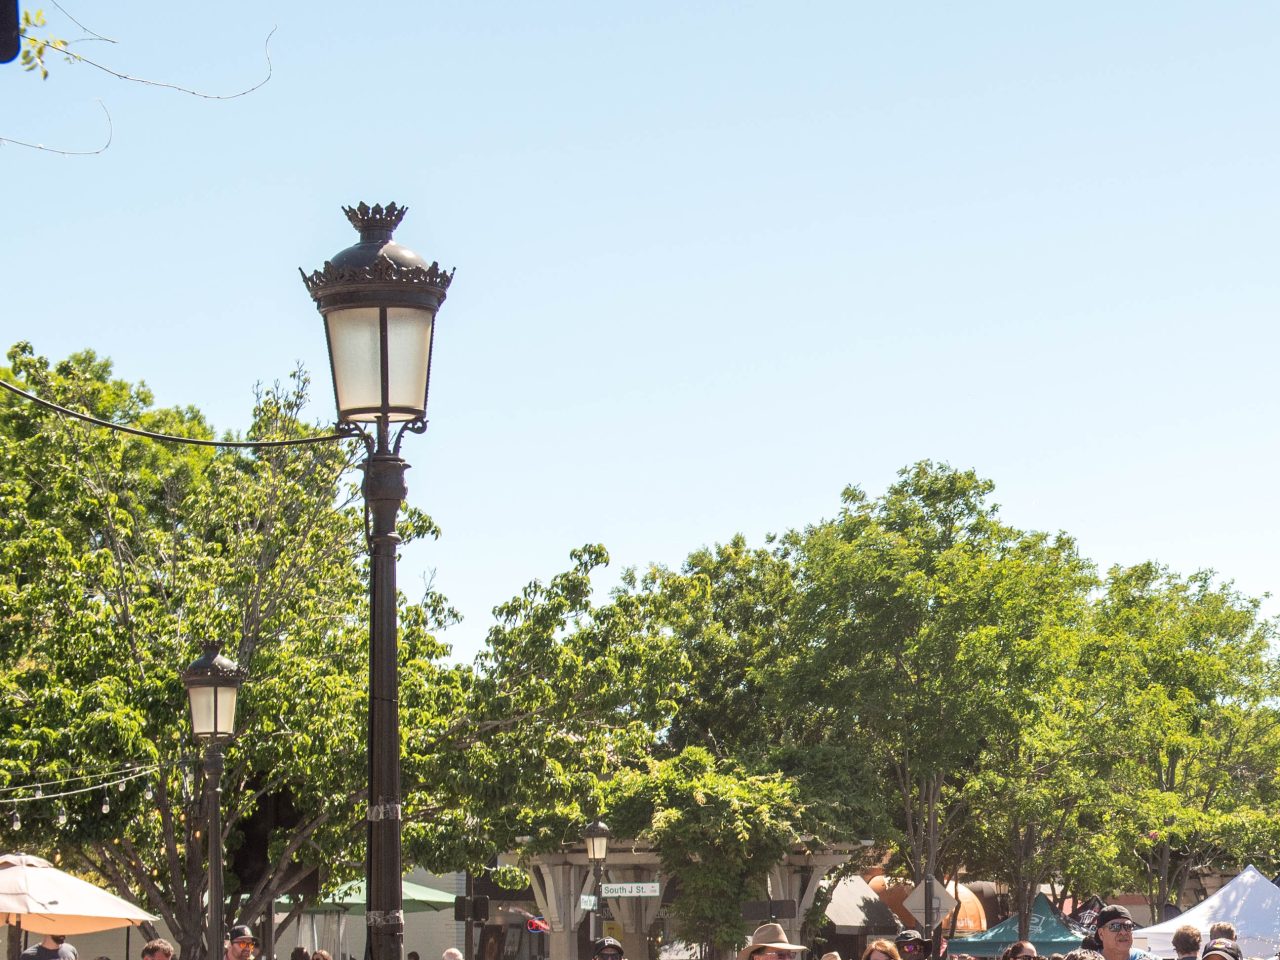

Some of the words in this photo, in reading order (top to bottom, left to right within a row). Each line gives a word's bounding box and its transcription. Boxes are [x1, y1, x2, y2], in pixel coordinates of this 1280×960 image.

[604, 886, 627, 894] South
[628, 886, 633, 894] J
[636, 886, 646, 894] St.
